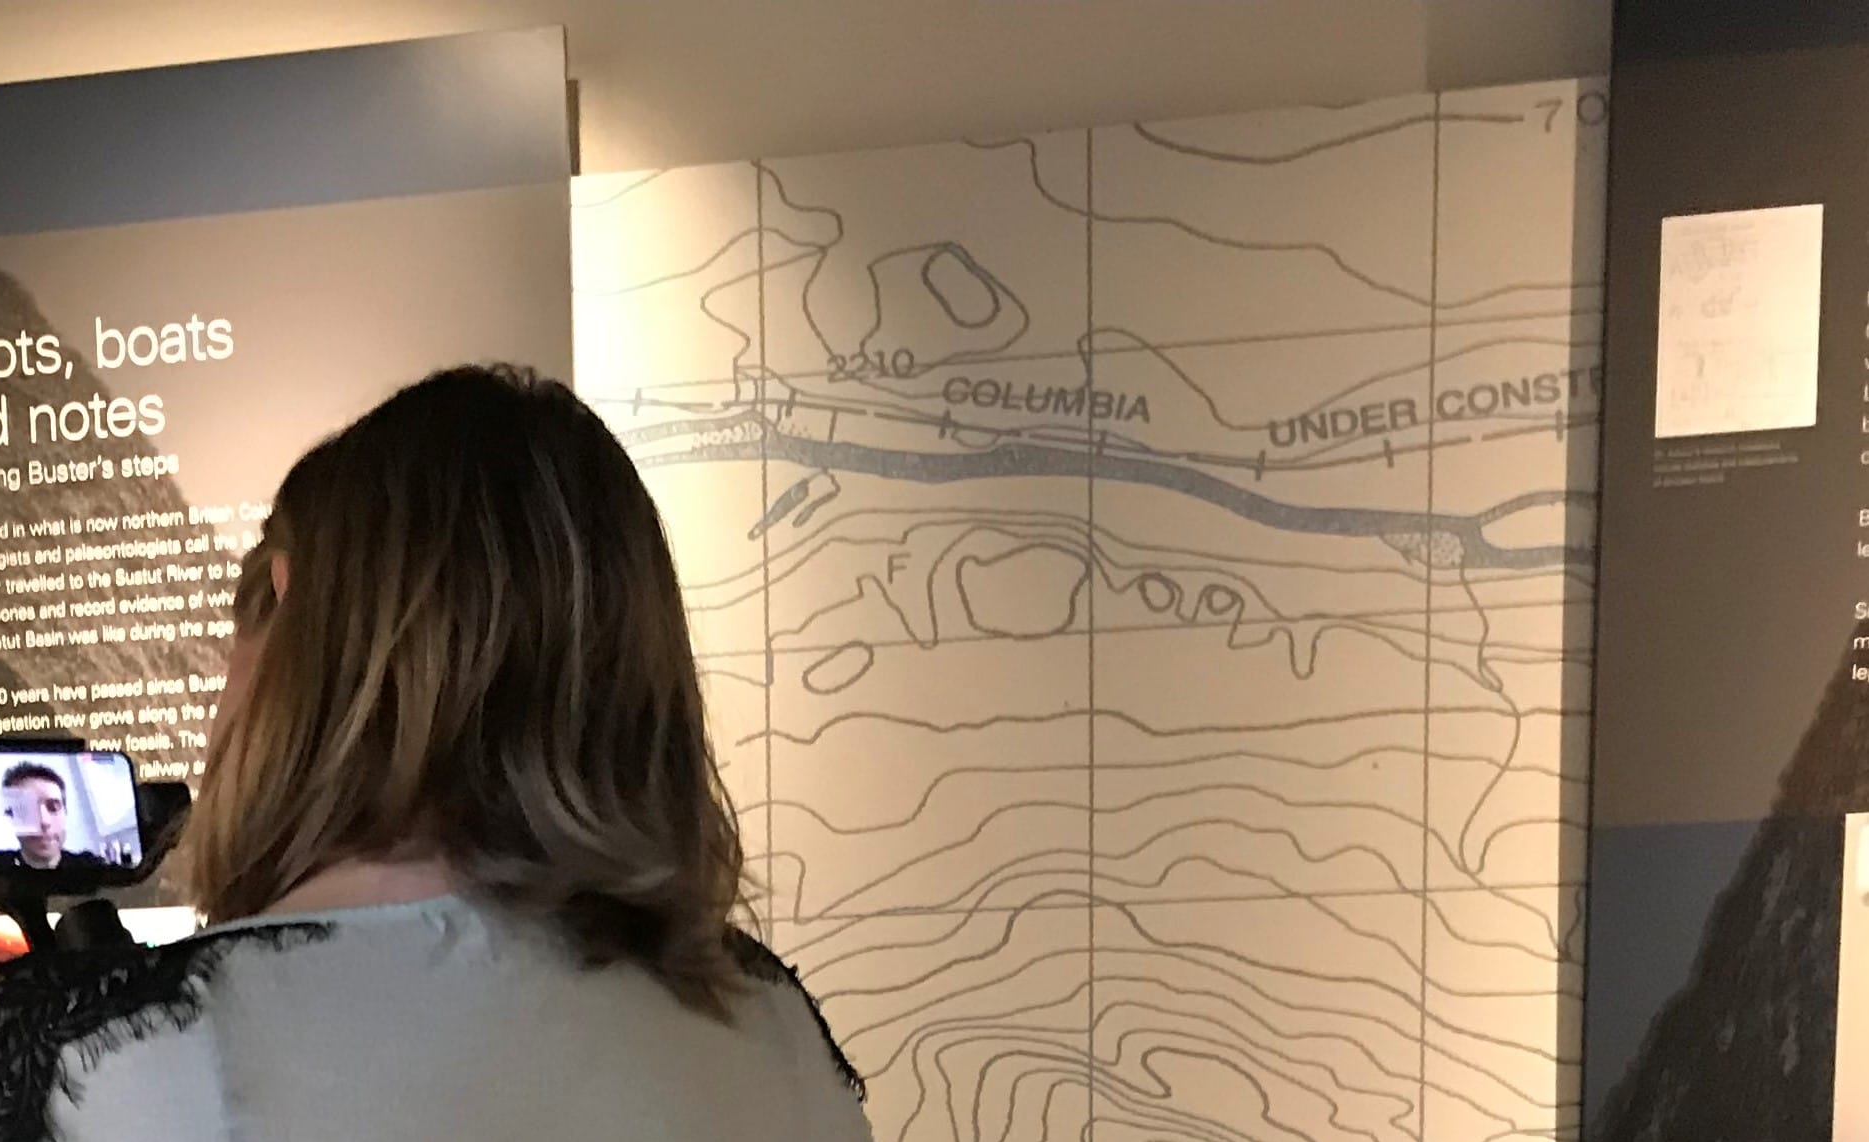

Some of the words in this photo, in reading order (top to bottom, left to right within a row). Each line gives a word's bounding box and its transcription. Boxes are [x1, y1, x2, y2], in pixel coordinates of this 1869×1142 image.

[95, 313, 235, 369] boats
[942, 376, 1150, 424] COLUMBIA
[29, 392, 166, 443] notes
[1268, 398, 1418, 447] UNDER
[28, 454, 114, 485] Buster's
[121, 454, 179, 480] steps
[12, 523, 26, 538] in
[29, 519, 66, 537] what
[69, 518, 82, 535] is
[86, 516, 119, 533] now
[122, 510, 184, 530] northern
[34, 545, 62, 565] and
[184, 533, 210, 554] call
[5, 572, 65, 595] travelled
[69, 573, 84, 590] to
[87, 570, 112, 589] the
[115, 567, 163, 587] Sustut
[166, 564, 204, 583] River
[207, 563, 224, 580] to
[39, 600, 66, 620] and
[69, 596, 116, 618] record
[119, 593, 185, 614] evidence
[188, 589, 204, 610] of
[25, 630, 65, 648] Basin
[67, 629, 99, 645] was
[102, 625, 126, 643] like
[129, 622, 176, 642] during
[179, 620, 204, 638] the
[207, 620, 235, 639] age
[10, 687, 51, 707] years
[53, 683, 87, 701] have
[91, 677, 144, 702] passed
[146, 677, 185, 696] since
[54, 713, 86, 729] now
[89, 709, 135, 730] grows
[138, 705, 178, 725] along
[180, 702, 205, 721] the
[89, 738, 122, 752] new
[125, 732, 174, 752] fossils.
[177, 729, 207, 748] The
[139, 760, 190, 779] railway
